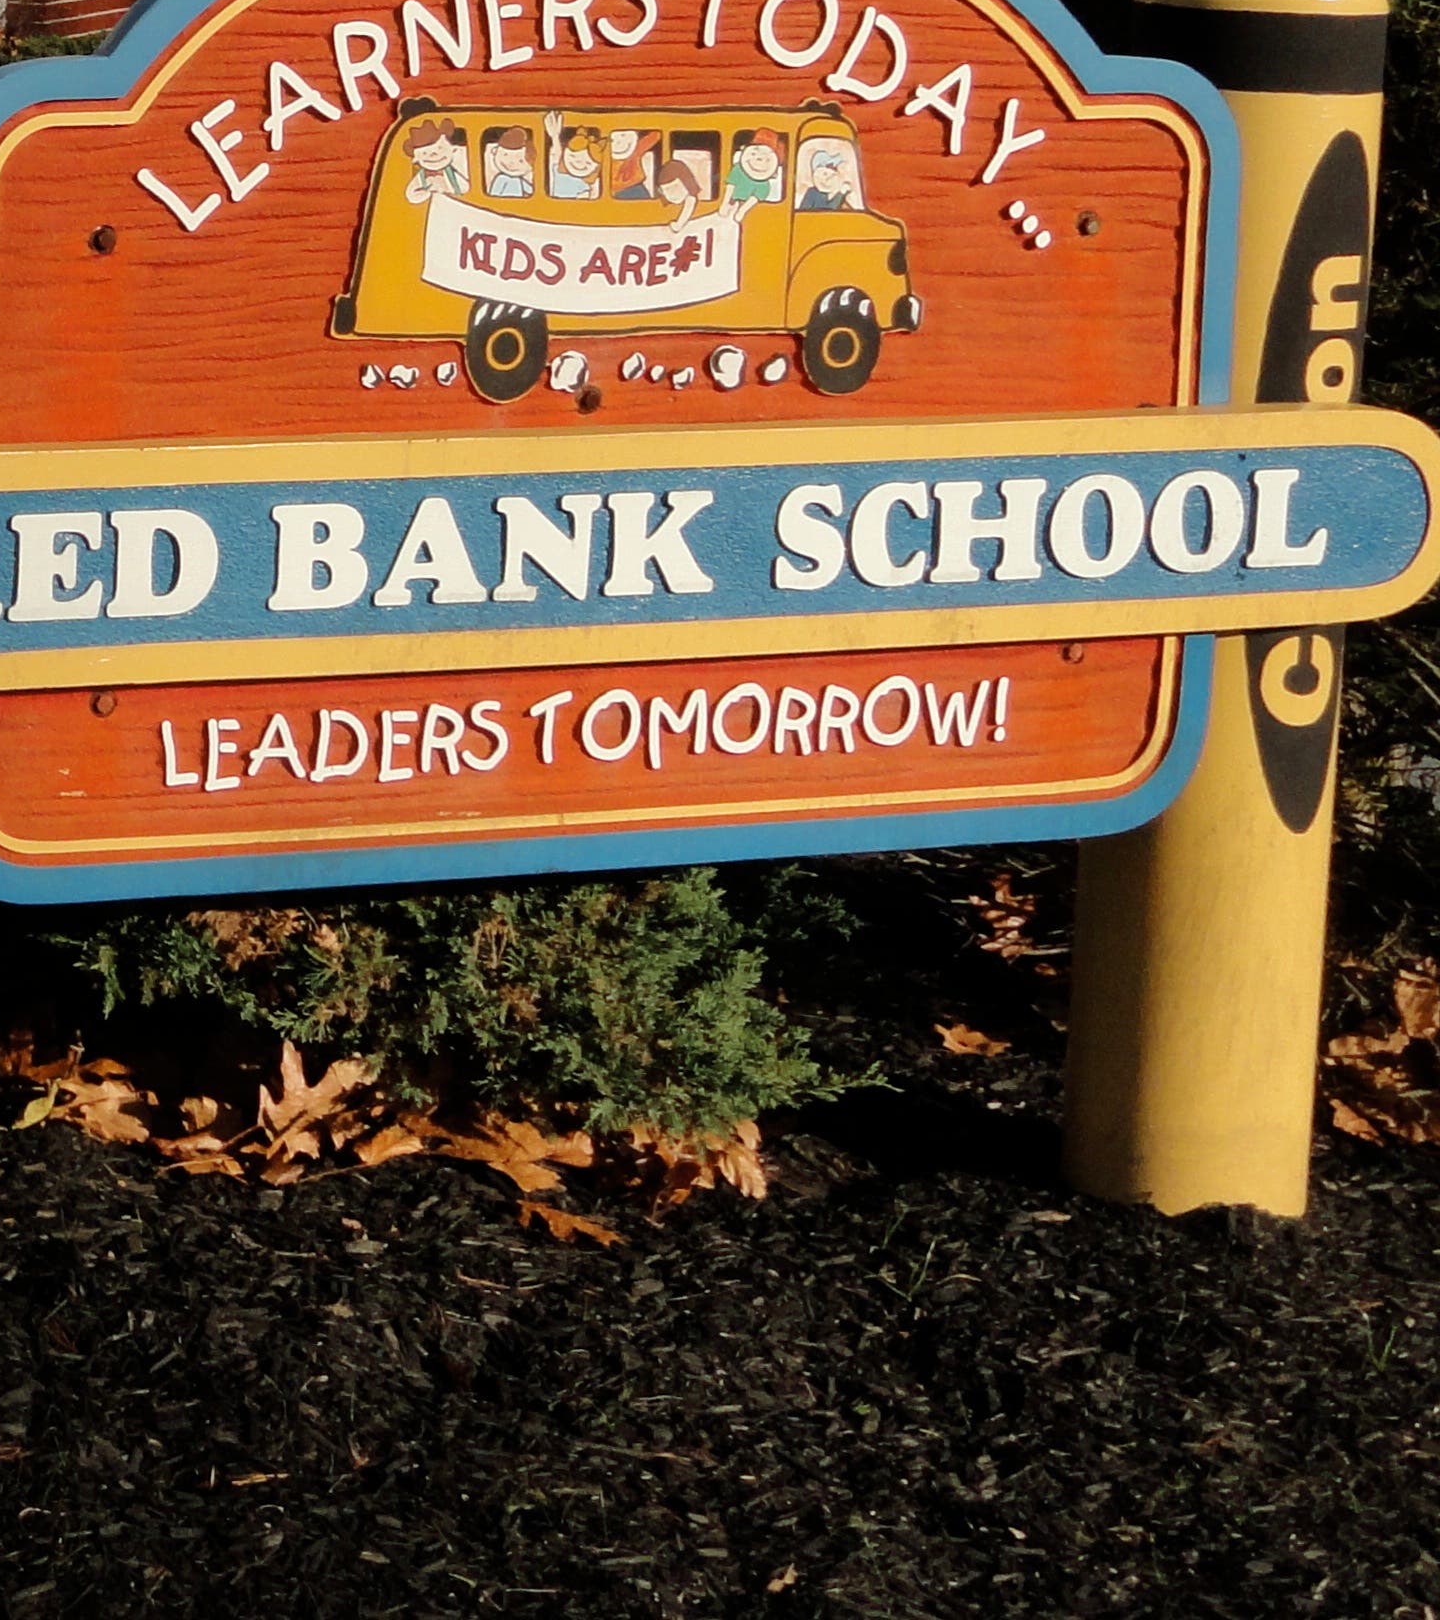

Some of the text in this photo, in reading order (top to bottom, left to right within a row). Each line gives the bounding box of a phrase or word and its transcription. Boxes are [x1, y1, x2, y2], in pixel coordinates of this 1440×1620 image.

[458, 226, 567, 285] KIDS
[267, 485, 719, 612] BANK
[774, 465, 1330, 593] SCHOOL
[160, 674, 1011, 792] LEADERS TOMORROW!
